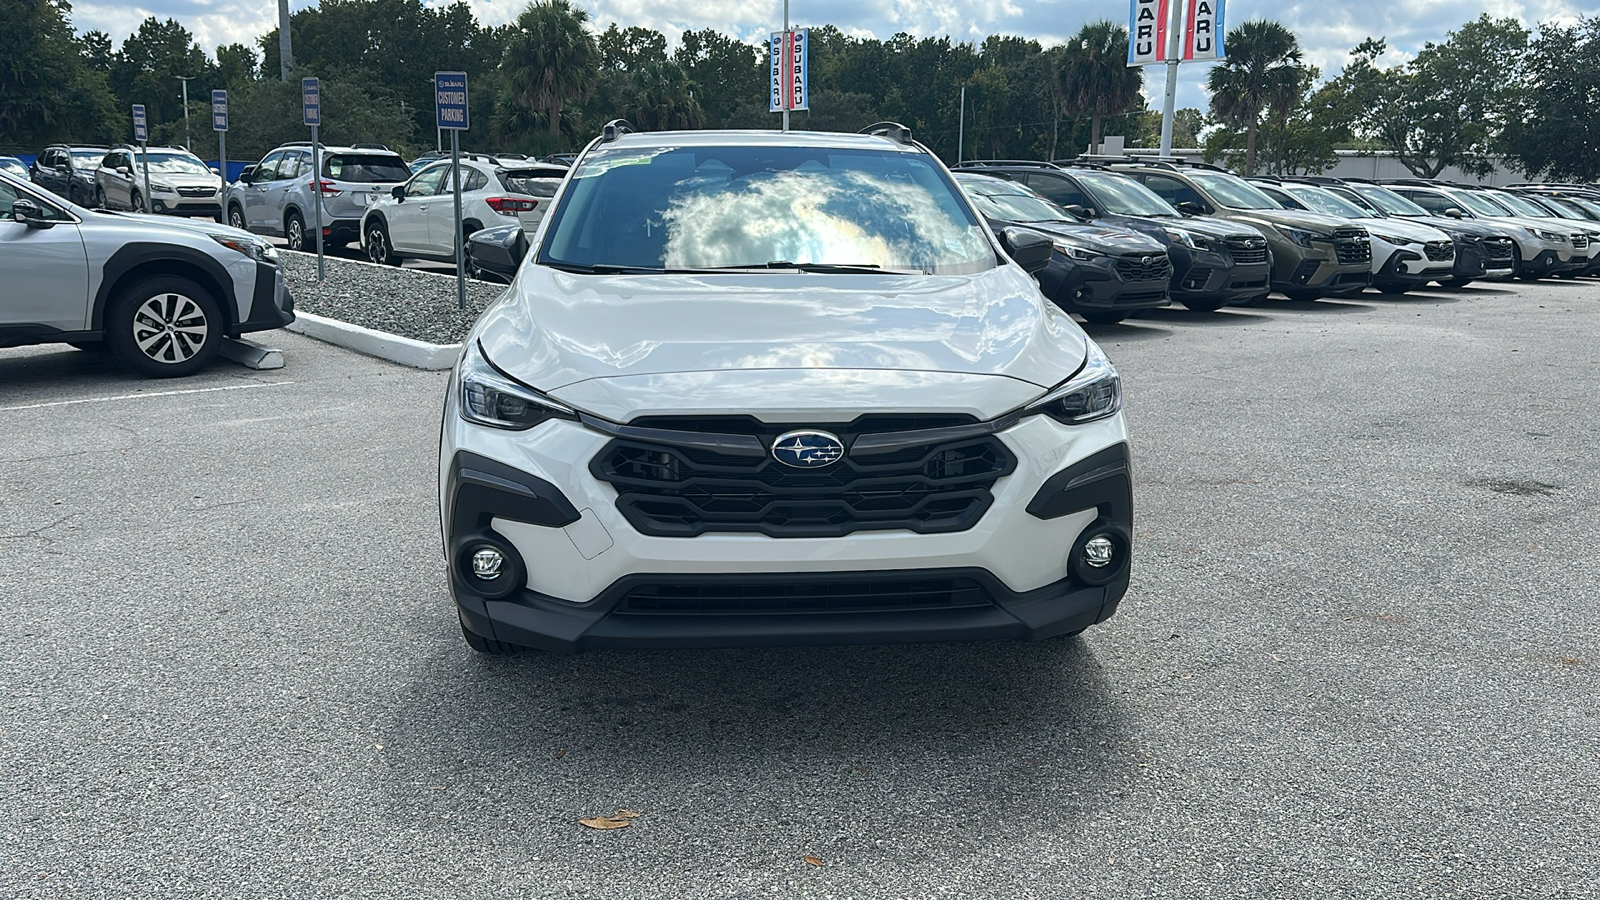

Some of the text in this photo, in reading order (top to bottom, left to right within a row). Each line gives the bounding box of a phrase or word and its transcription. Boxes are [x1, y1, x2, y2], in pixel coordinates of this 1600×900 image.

[1137, 0, 1154, 55] ARU
[438, 91, 465, 105] CUSTOMER
[773, 47, 781, 106] SUBARU
[794, 44, 803, 105] SUBARU
[441, 108, 464, 122] PARKING
